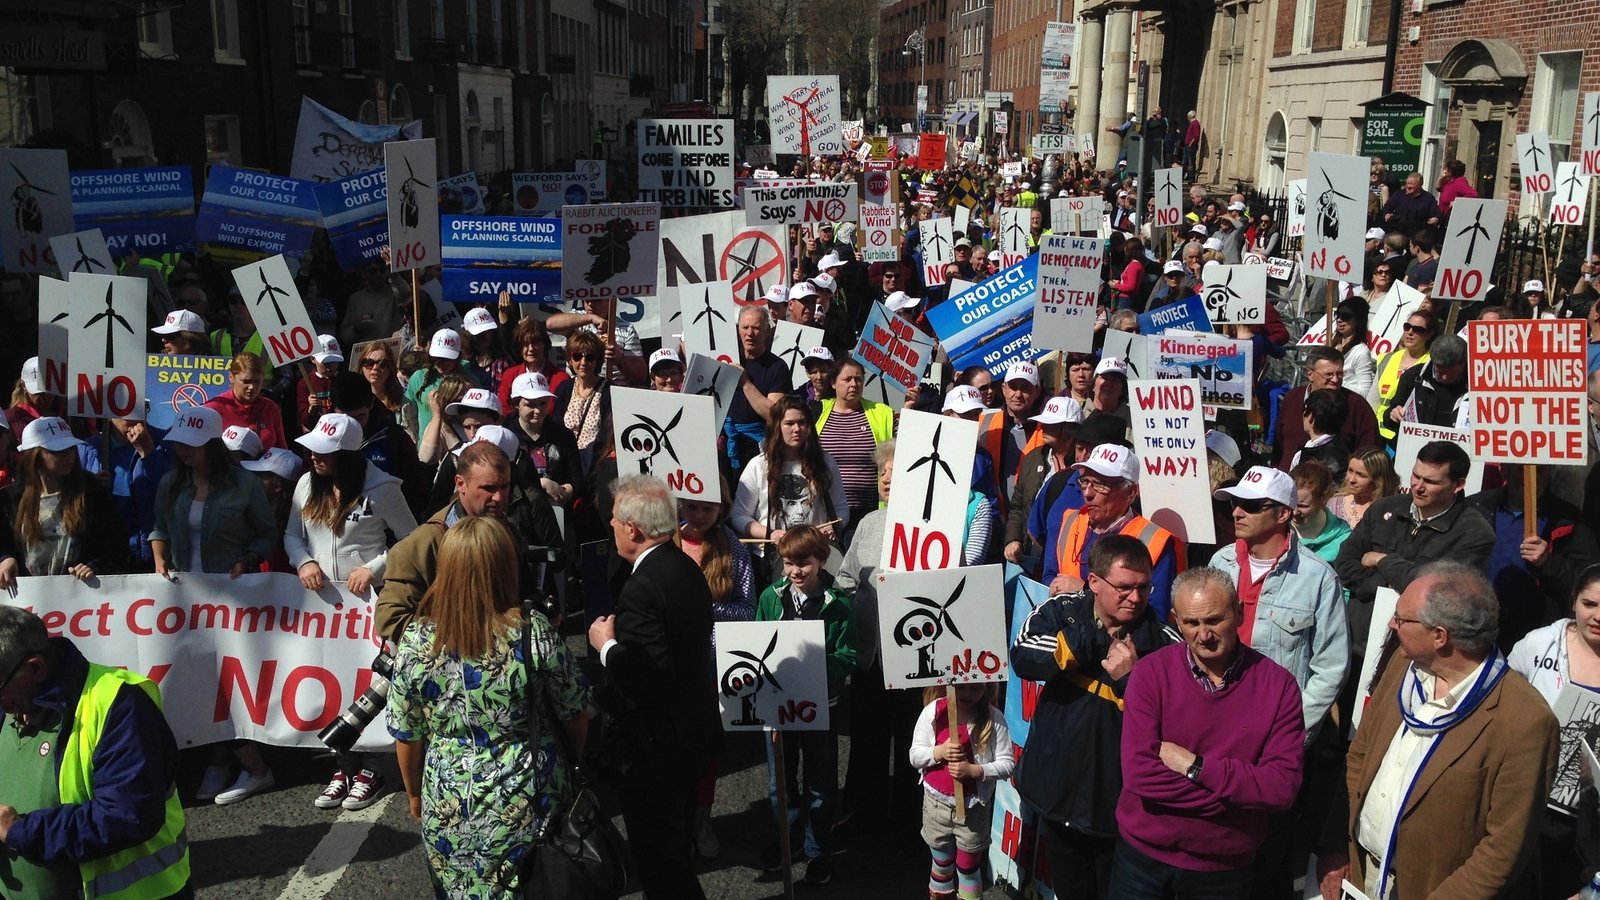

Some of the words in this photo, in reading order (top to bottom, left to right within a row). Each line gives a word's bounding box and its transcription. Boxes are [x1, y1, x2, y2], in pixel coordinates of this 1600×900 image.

[792, 86, 808, 100] PART
[811, 79, 820, 88] OF
[787, 107, 796, 117] TO
[777, 121, 795, 135] WIND
[784, 134, 795, 144] DO
[817, 114, 831, 126] NOT
[1367, 120, 1389, 129] FOR
[645, 124, 724, 147] FAMILIES
[1366, 128, 1395, 137] SALE
[818, 142, 840, 151] GOV
[1040, 135, 1063, 148] FFS!
[641, 153, 674, 167] COME
[680, 152, 730, 167] BEFORE
[752, 149, 770, 158] NO
[1084, 149, 1094, 158] NO
[1392, 164, 1415, 172] 5500
[71, 173, 141, 186] OFFSHORE
[143, 171, 181, 184] WIND
[234, 172, 300, 192] PROTECT
[341, 170, 387, 194] PROTE
[450, 174, 475, 188] SAYS
[513, 174, 563, 182] WEXFORD
[565, 174, 588, 182] SAYS
[661, 170, 716, 187] WIND
[870, 180, 888, 190] STOP
[1526, 173, 1550, 194] NO
[72, 189, 80, 197] A
[82, 185, 133, 196] PLANNING
[136, 183, 182, 193] SCANDAL
[229, 185, 256, 198] OUR
[260, 191, 298, 204] COAST
[542, 183, 562, 192] NO!
[345, 194, 371, 208] OUR
[639, 189, 733, 206] TURBINES
[751, 189, 777, 202] This
[565, 207, 595, 219] RABBIT
[597, 206, 657, 218] AUCTIONEERS
[1069, 200, 1084, 210] NO
[1158, 207, 1180, 225] NO
[1553, 204, 1580, 223] NO
[451, 220, 517, 232] OFFSHORE
[520, 222, 556, 233] WIND
[568, 223, 606, 235] FOR
[866, 217, 891, 227] Wind
[106, 234, 131, 248] AY
[134, 232, 168, 247] NO!
[220, 223, 235, 232] NO
[238, 225, 287, 242] OFFSHORE
[461, 233, 509, 242] PLANNING
[511, 234, 555, 243] SCANDAL
[218, 233, 245, 246] WIND
[248, 238, 285, 252] EXPORT
[359, 236, 374, 248] NO
[1048, 238, 1066, 248] ARE
[1072, 239, 1084, 250] WE
[1089, 241, 1096, 251] A
[396, 241, 426, 268] NO
[863, 249, 896, 260] Turbine's
[1041, 253, 1100, 270] DEMOCRACY
[1311, 247, 1351, 276] NO
[469, 281, 501, 294] SAY
[507, 282, 537, 295] NO!
[954, 265, 1026, 311] PROTECT
[1439, 268, 1483, 299] NO
[565, 286, 611, 299] SOLD
[616, 284, 654, 297] OUT
[1041, 288, 1096, 307] LISTEN
[961, 305, 990, 325] OUR
[992, 279, 1036, 307] COAST
[479, 313, 490, 321] NO
[1044, 306, 1057, 314] TO
[1066, 307, 1084, 316] US!
[1151, 303, 1189, 328] PROTECT
[1236, 306, 1259, 321] NO
[165, 315, 175, 323] NO
[890, 317, 914, 343] NO
[268, 326, 314, 364] NO
[444, 338, 456, 347] NO
[1476, 323, 1533, 354] BURY
[1538, 323, 1581, 353] THE
[872, 325, 919, 368] WIND
[1160, 339, 1237, 360] Kinnegad
[859, 339, 919, 389] TURBINES
[983, 349, 1002, 365] NO
[1160, 355, 1174, 363] Says
[46, 359, 67, 395] N
[158, 370, 193, 384] SAY
[198, 373, 225, 386] NO
[1022, 366, 1034, 375] NO
[1473, 358, 1584, 388] POWERLINES
[77, 373, 137, 417] NO
[468, 392, 482, 400] NO
[1136, 385, 1194, 411] WIND
[1047, 403, 1059, 414] NO
[1476, 396, 1525, 424] NOT
[1532, 397, 1581, 426] THE
[187, 416, 204, 429] NO
[320, 423, 337, 437] NO
[1145, 417, 1156, 429] IS
[1165, 417, 1190, 429] NOT
[225, 429, 238, 439] NO
[1144, 437, 1164, 448] THE
[1166, 437, 1196, 450] ONLY
[1474, 429, 1583, 460] PEOPLE
[1100, 448, 1119, 463] NO
[1144, 456, 1197, 478] WAY!
[667, 469, 704, 494] NO
[1244, 471, 1263, 483] NO
[890, 522, 950, 571] NO
[952, 648, 1001, 675] NO
[778, 699, 817, 725] NO
